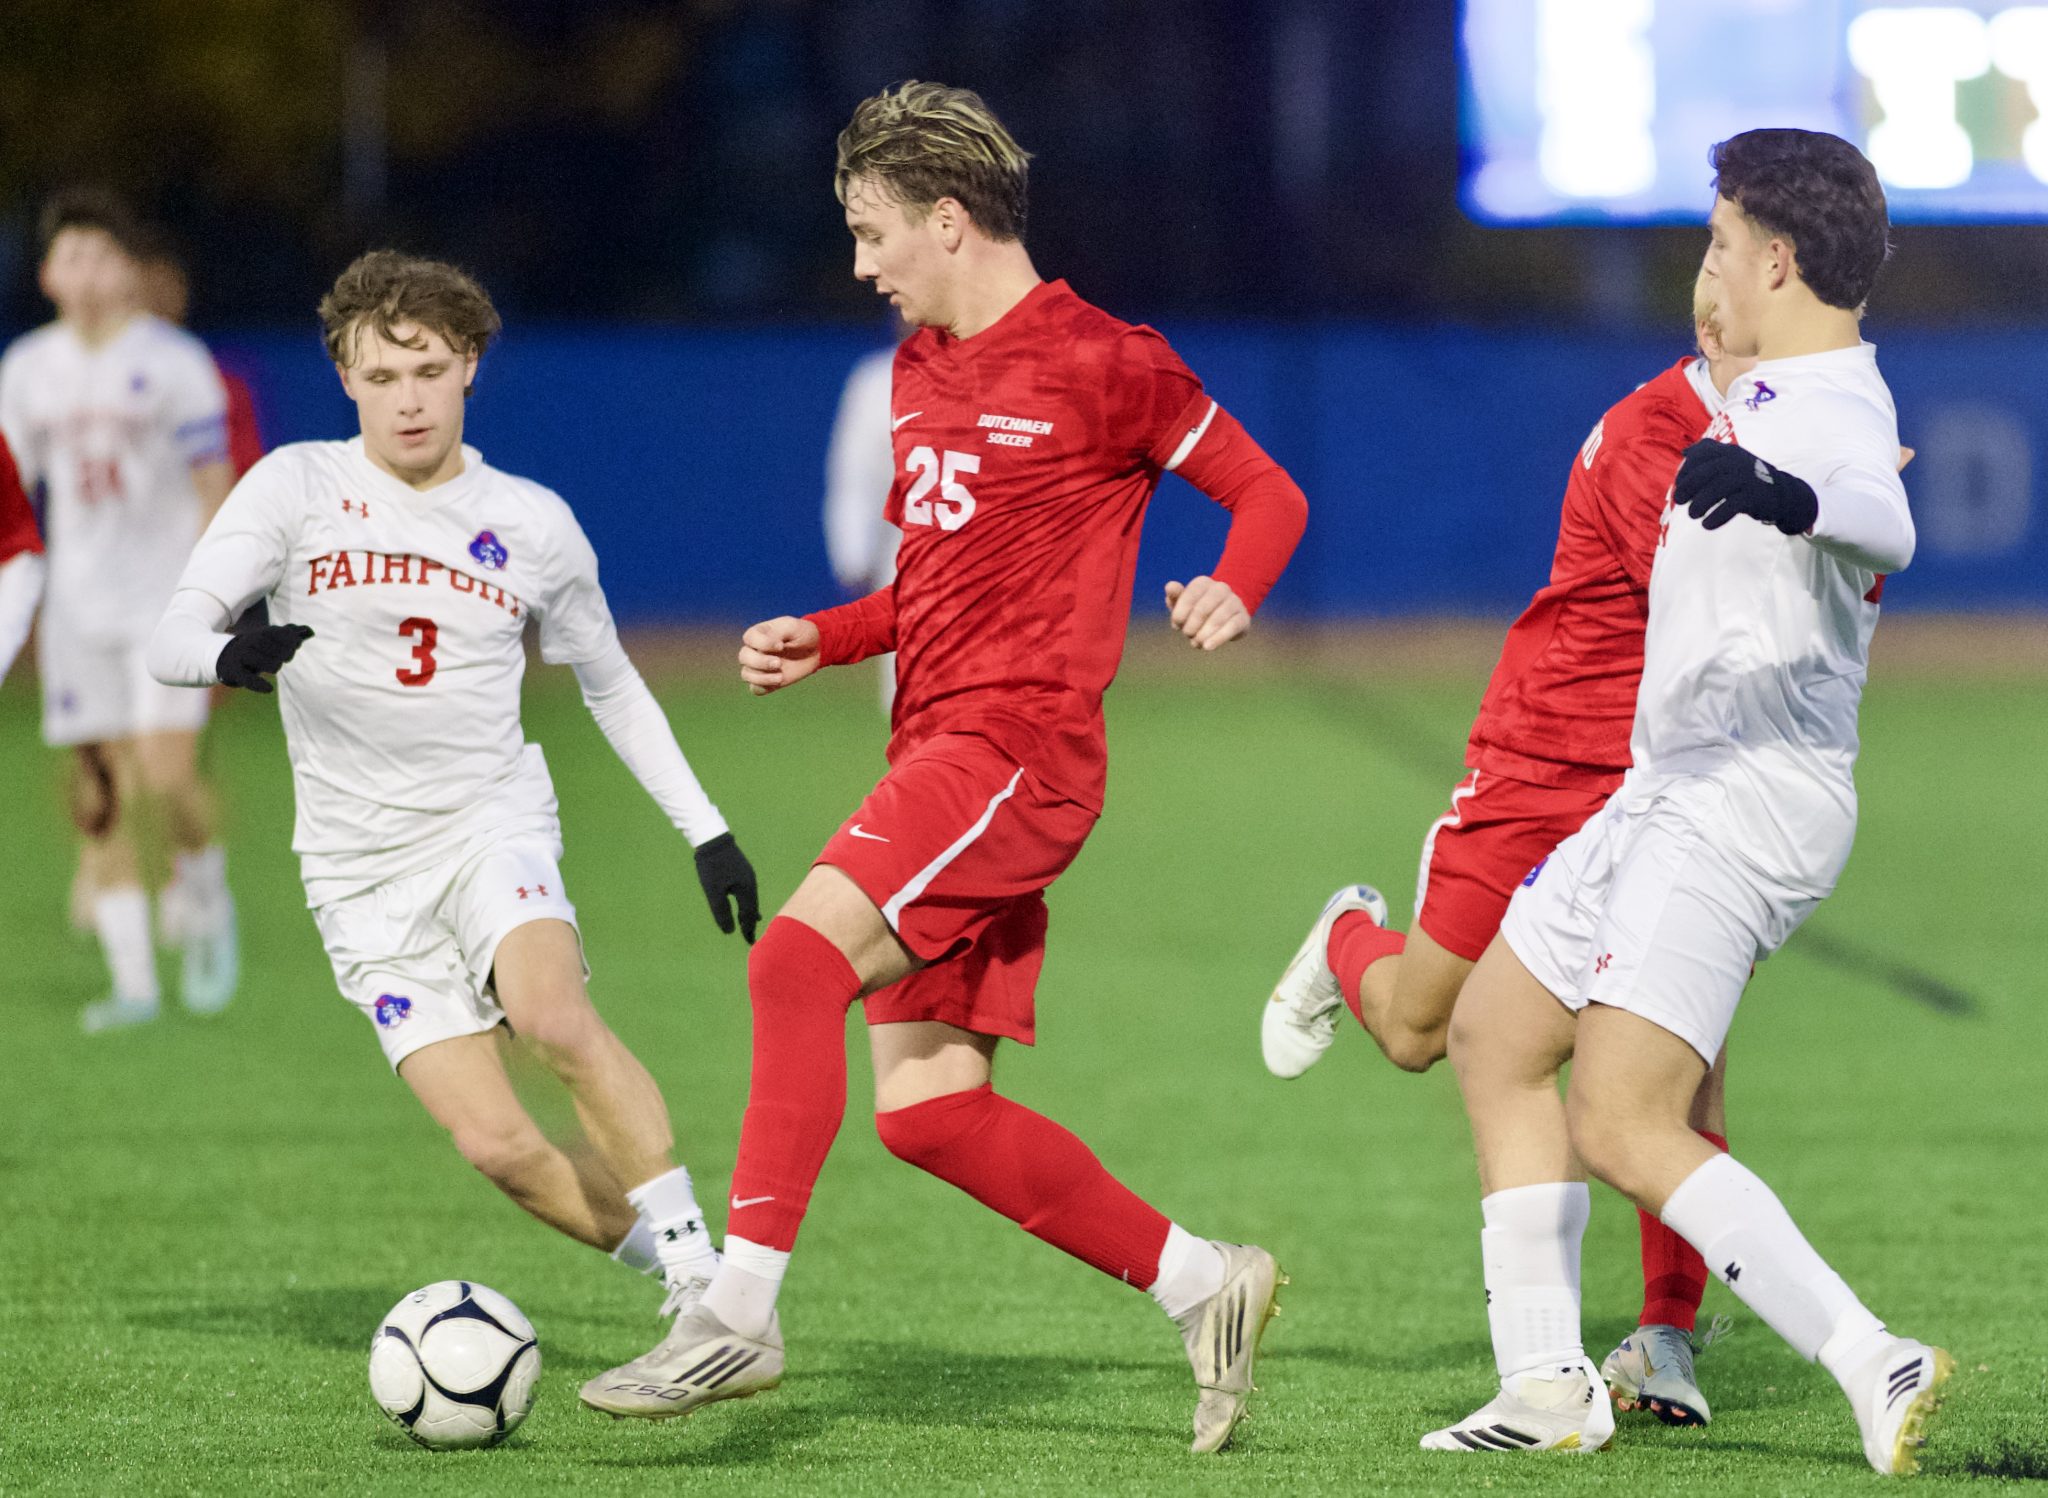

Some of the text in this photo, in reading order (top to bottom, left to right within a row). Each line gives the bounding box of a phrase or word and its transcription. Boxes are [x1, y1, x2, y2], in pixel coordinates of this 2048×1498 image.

[976, 414, 1054, 435] DUTCHMEN
[986, 432, 1033, 448] SOCCER
[905, 446, 981, 531] 25
[396, 617, 438, 687] 3
[604, 1383, 690, 1401] F50
